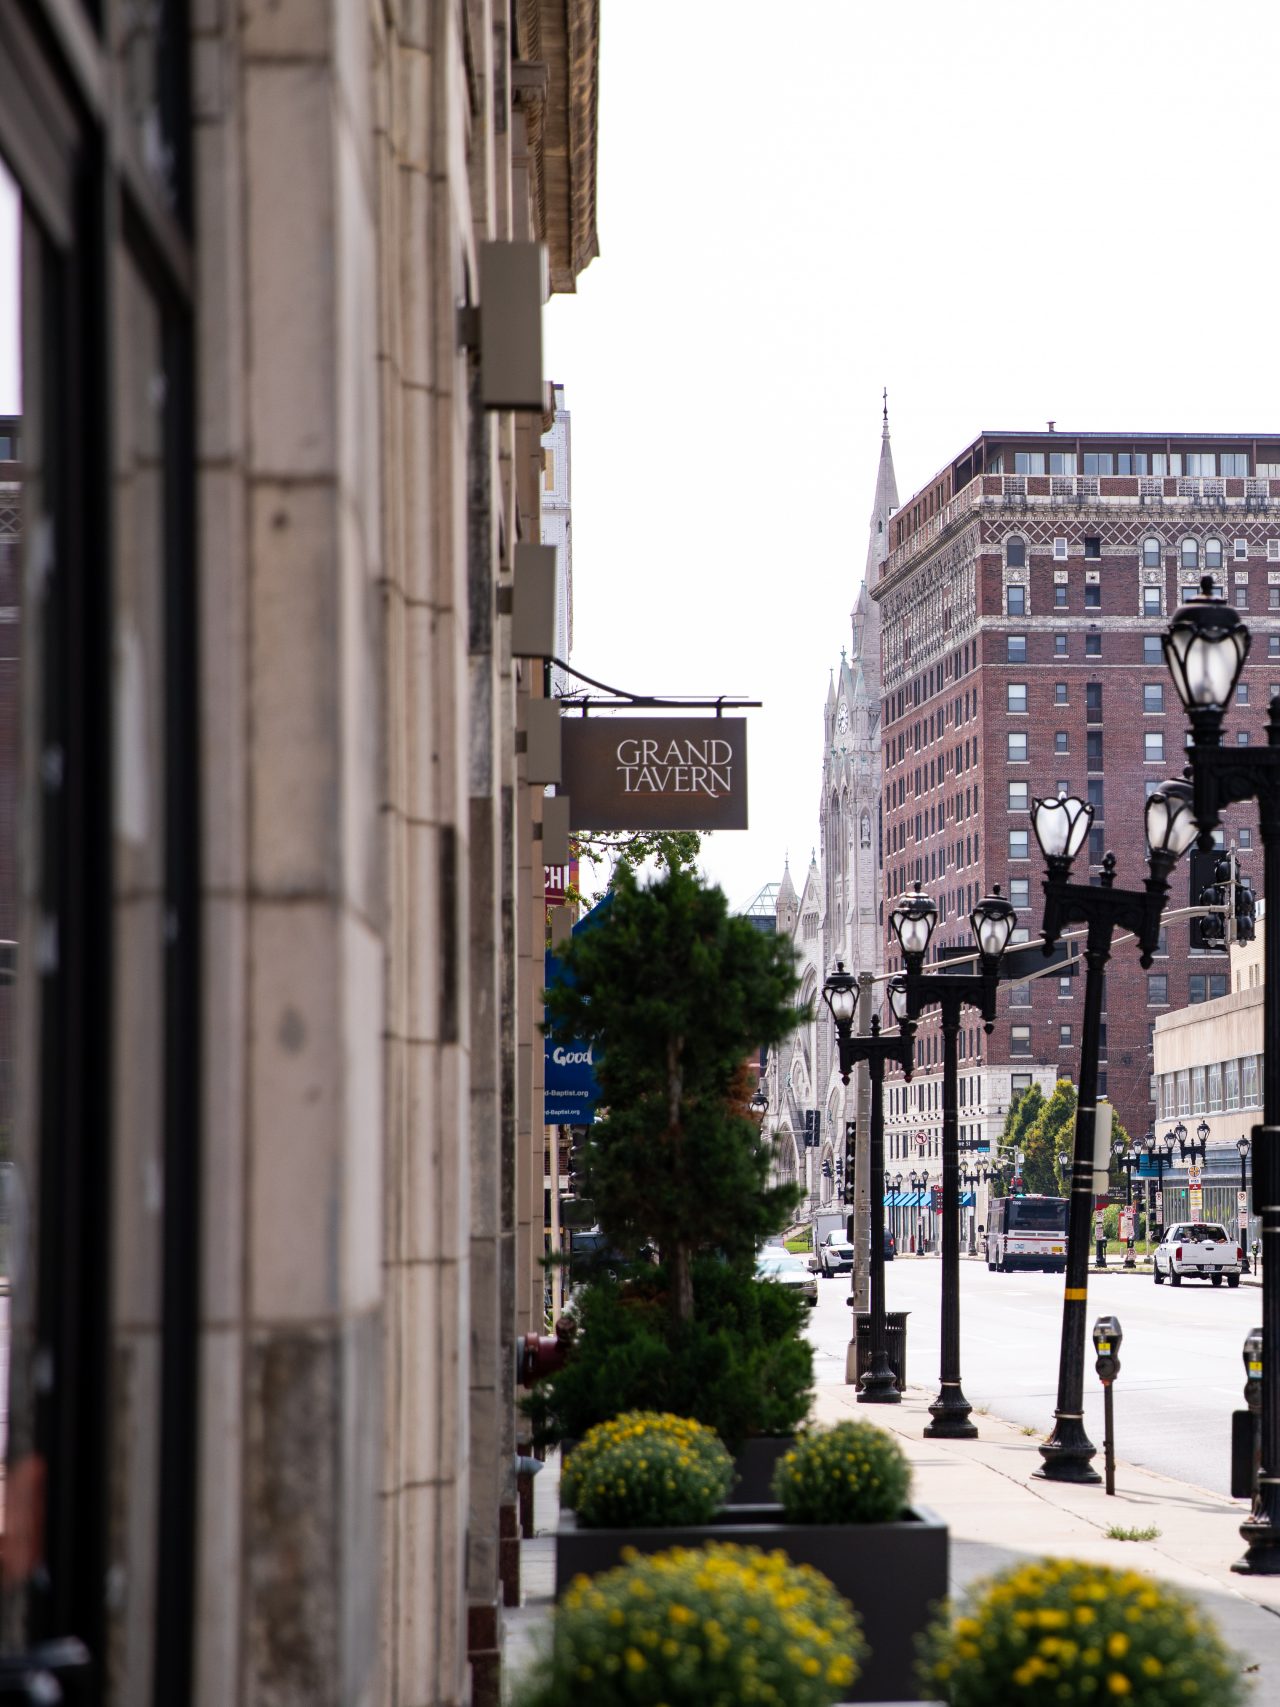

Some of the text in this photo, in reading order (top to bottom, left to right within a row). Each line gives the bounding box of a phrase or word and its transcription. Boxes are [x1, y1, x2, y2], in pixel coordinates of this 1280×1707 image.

[617, 739, 733, 765] GRAND
[616, 766, 732, 798] TAVERN
[553, 1040, 593, 1067] Good
